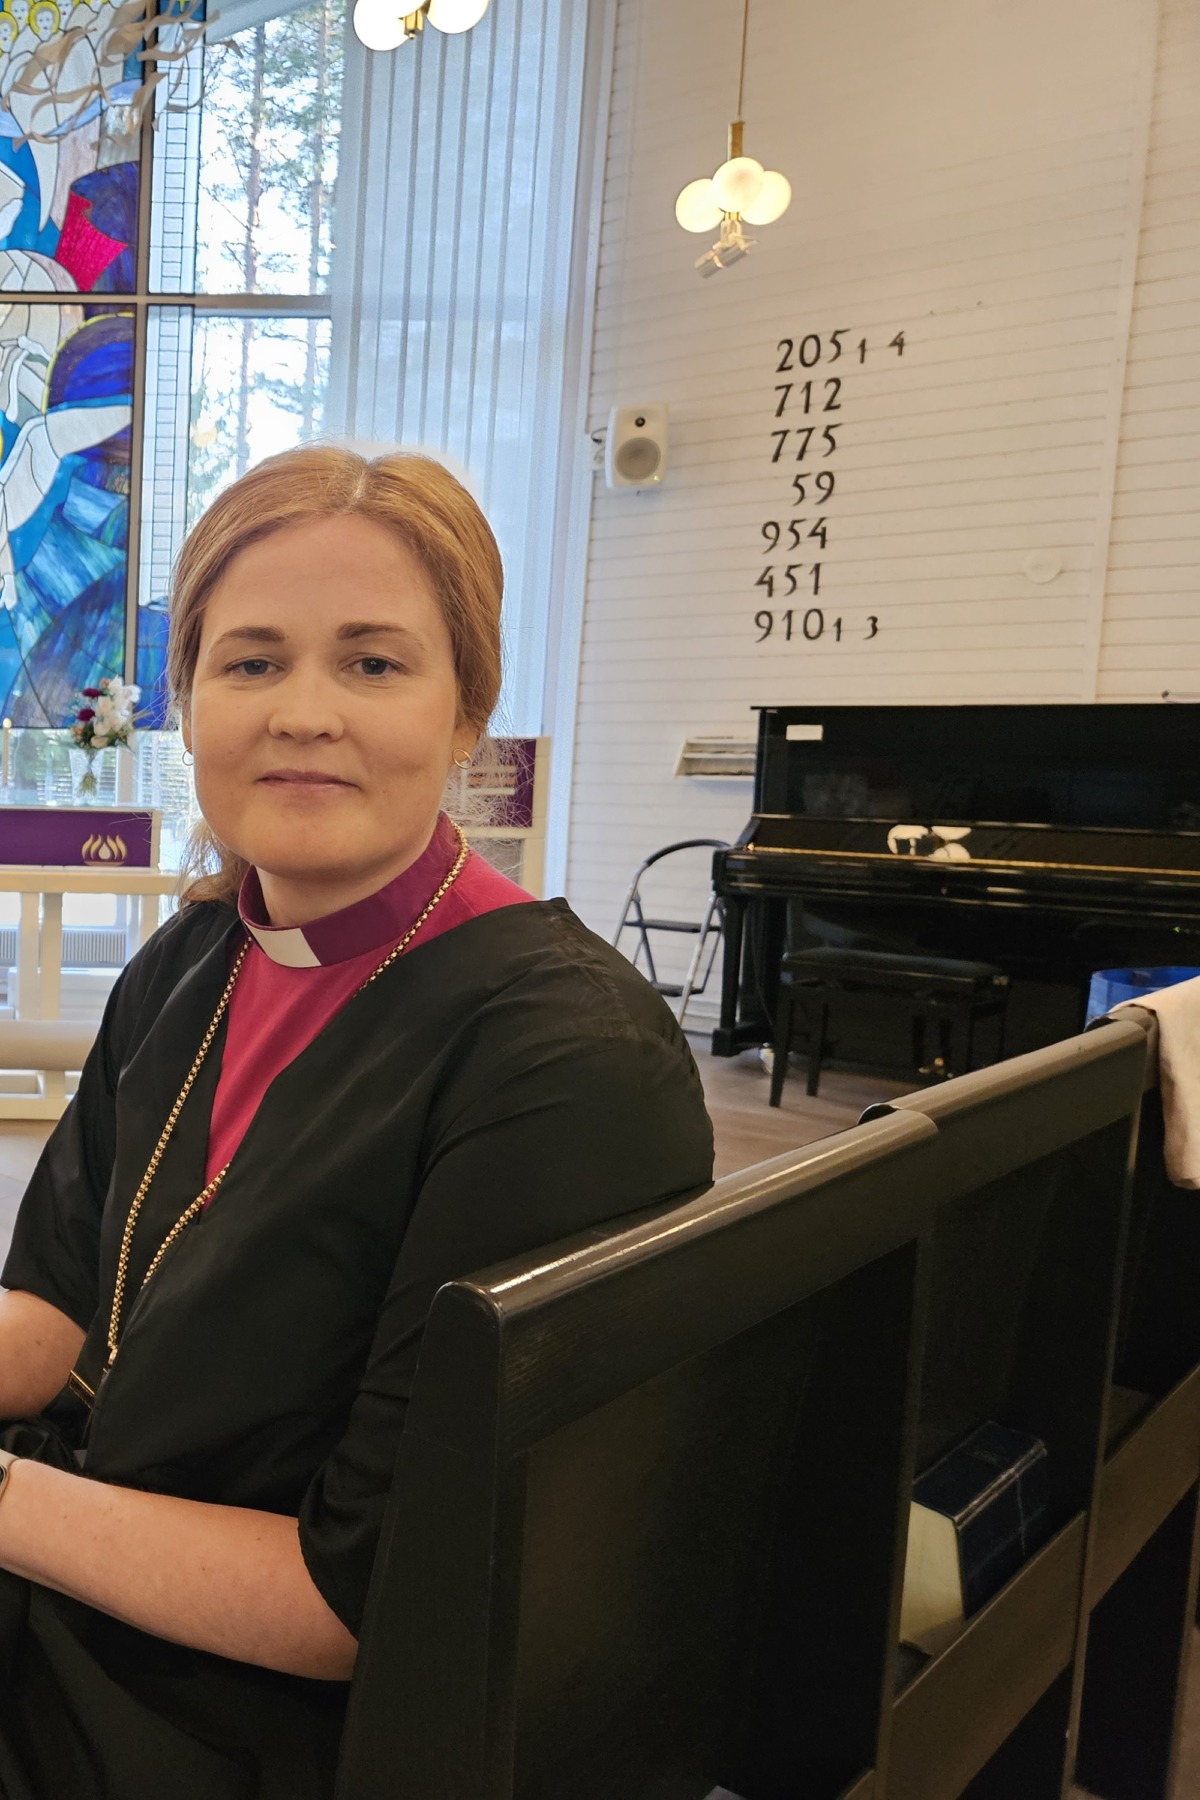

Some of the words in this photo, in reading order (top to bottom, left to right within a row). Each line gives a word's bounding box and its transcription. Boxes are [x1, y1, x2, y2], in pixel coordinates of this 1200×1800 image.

[774, 376, 842, 418] 712
[770, 422, 844, 464] 775
[791, 470, 836, 507] 59
[761, 516, 828, 555] 954
[754, 562, 823, 599] 451
